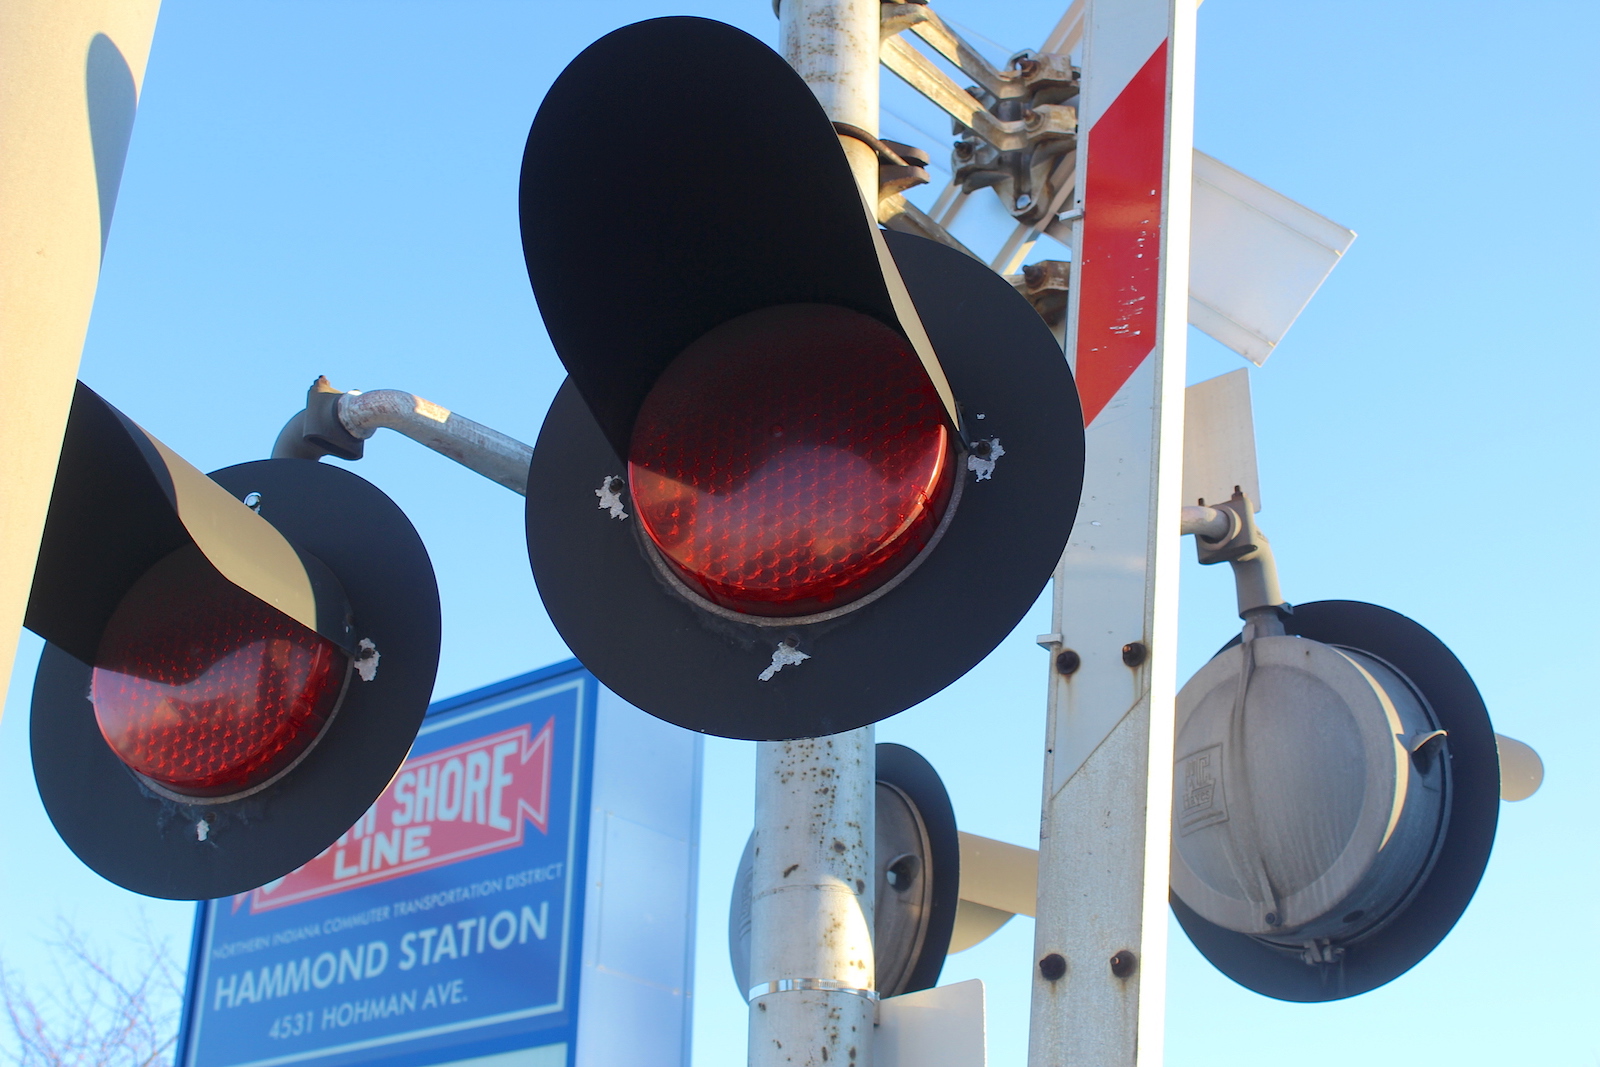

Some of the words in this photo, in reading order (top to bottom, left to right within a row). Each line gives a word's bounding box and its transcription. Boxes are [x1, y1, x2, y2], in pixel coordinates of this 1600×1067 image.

[392, 740, 518, 832] SHORE
[333, 826, 431, 880] LINE
[213, 936, 270, 959] NORTHERN
[272, 924, 321, 946] INDIANA
[323, 905, 390, 934] COMMUTER
[393, 879, 503, 917] TRANSPORTATION
[505, 862, 563, 891] DISTRICT
[214, 941, 389, 1011] HAMMOND
[398, 901, 549, 971] STATION
[269, 1011, 313, 1040] 4531
[322, 989, 417, 1030] HOHMAN
[422, 979, 468, 1010] AVE.
